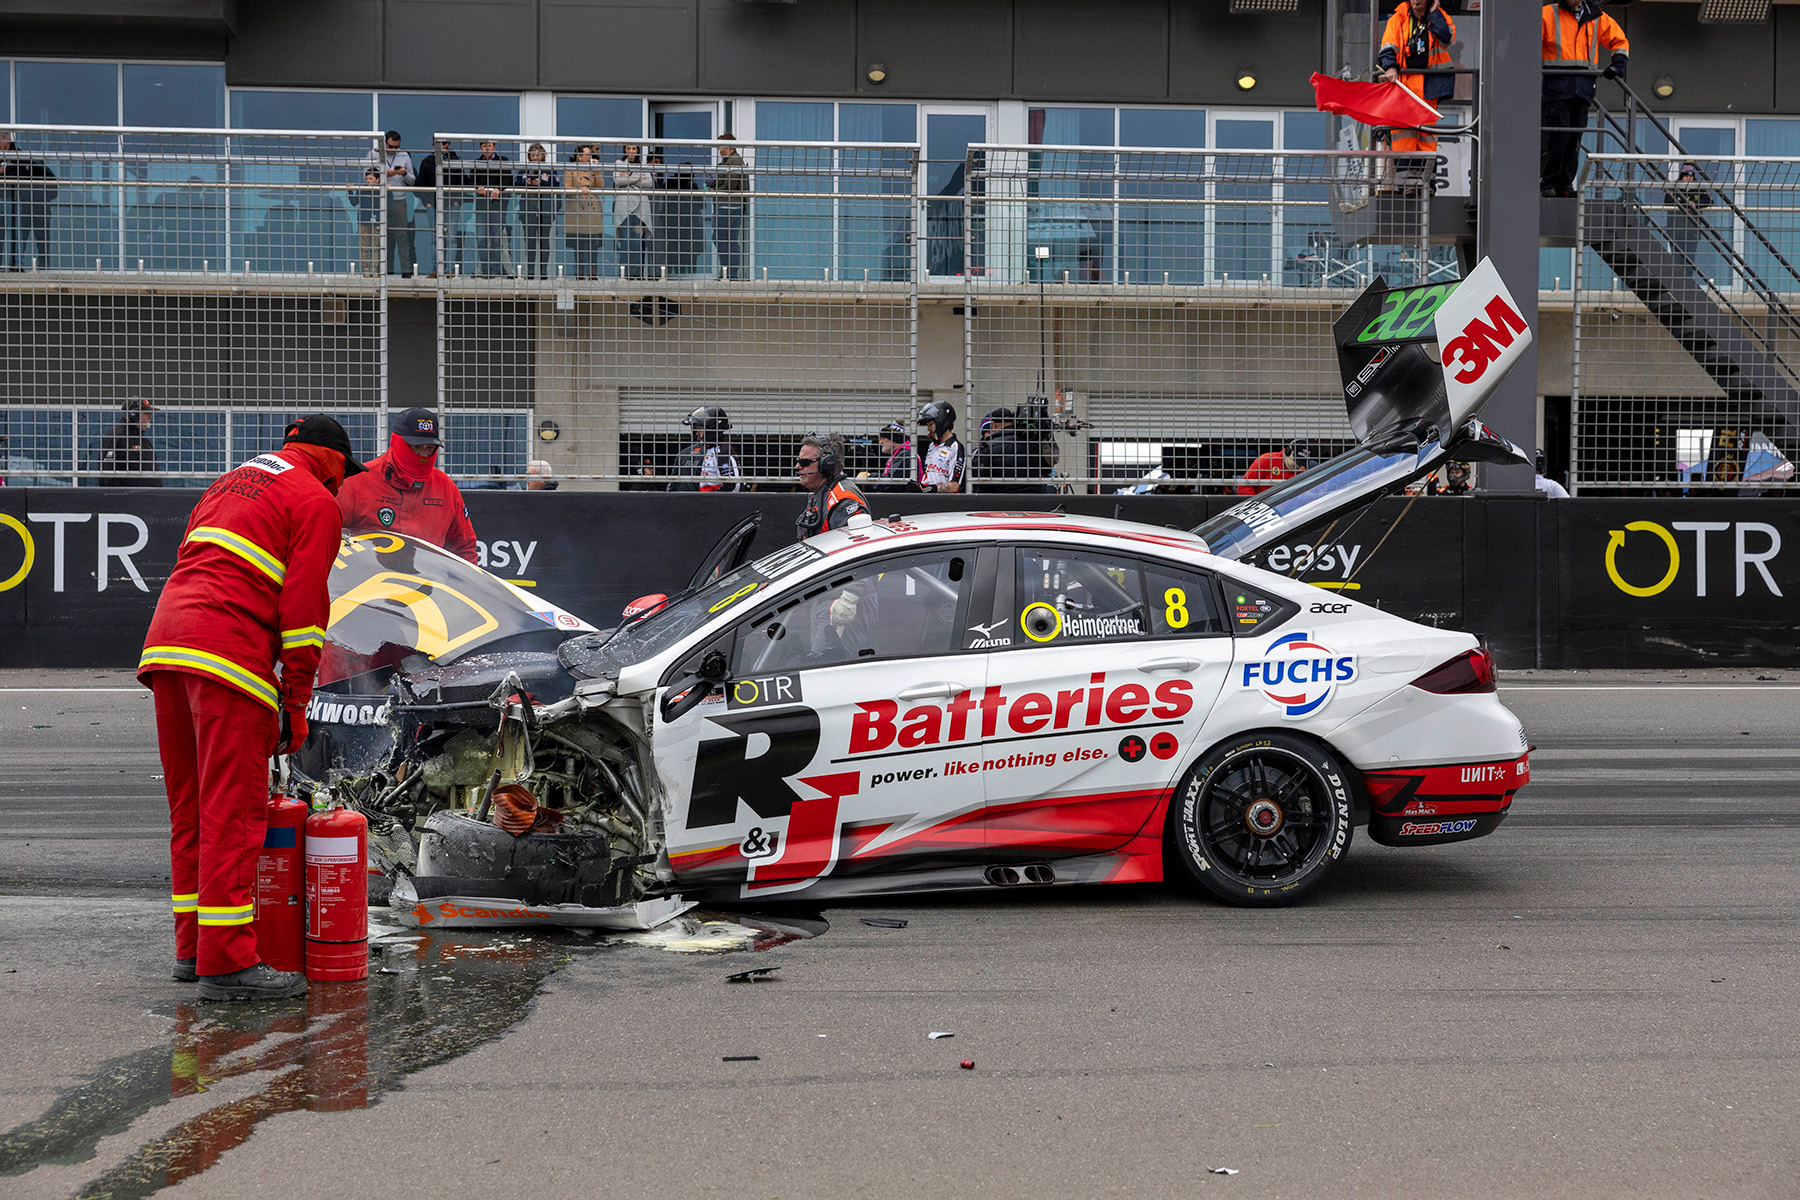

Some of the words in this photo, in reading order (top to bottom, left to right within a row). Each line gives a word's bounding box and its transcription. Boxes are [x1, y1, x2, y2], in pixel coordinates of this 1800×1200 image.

[1441, 294, 1528, 385] 3M
[476, 540, 538, 576] asy
[1267, 544, 1362, 579] easy
[1604, 520, 1784, 598] OTR
[708, 583, 758, 613] 8
[1163, 587, 1190, 629] 8
[1309, 602, 1353, 615] acer
[1062, 614, 1142, 639] Heimgartner
[1242, 656, 1354, 688] FUCHS
[733, 675, 796, 705] OTR
[848, 671, 1195, 755] Batteries
[870, 764, 938, 789] power.
[943, 760, 980, 777] like
[981, 750, 1058, 774] nothing
[1062, 746, 1110, 763] else.
[1461, 766, 1496, 783] UNIT
[1327, 773, 1349, 861] DUNLOP
[1399, 819, 1478, 836] SPEEDFLOW
[438, 902, 552, 919] Scandia
